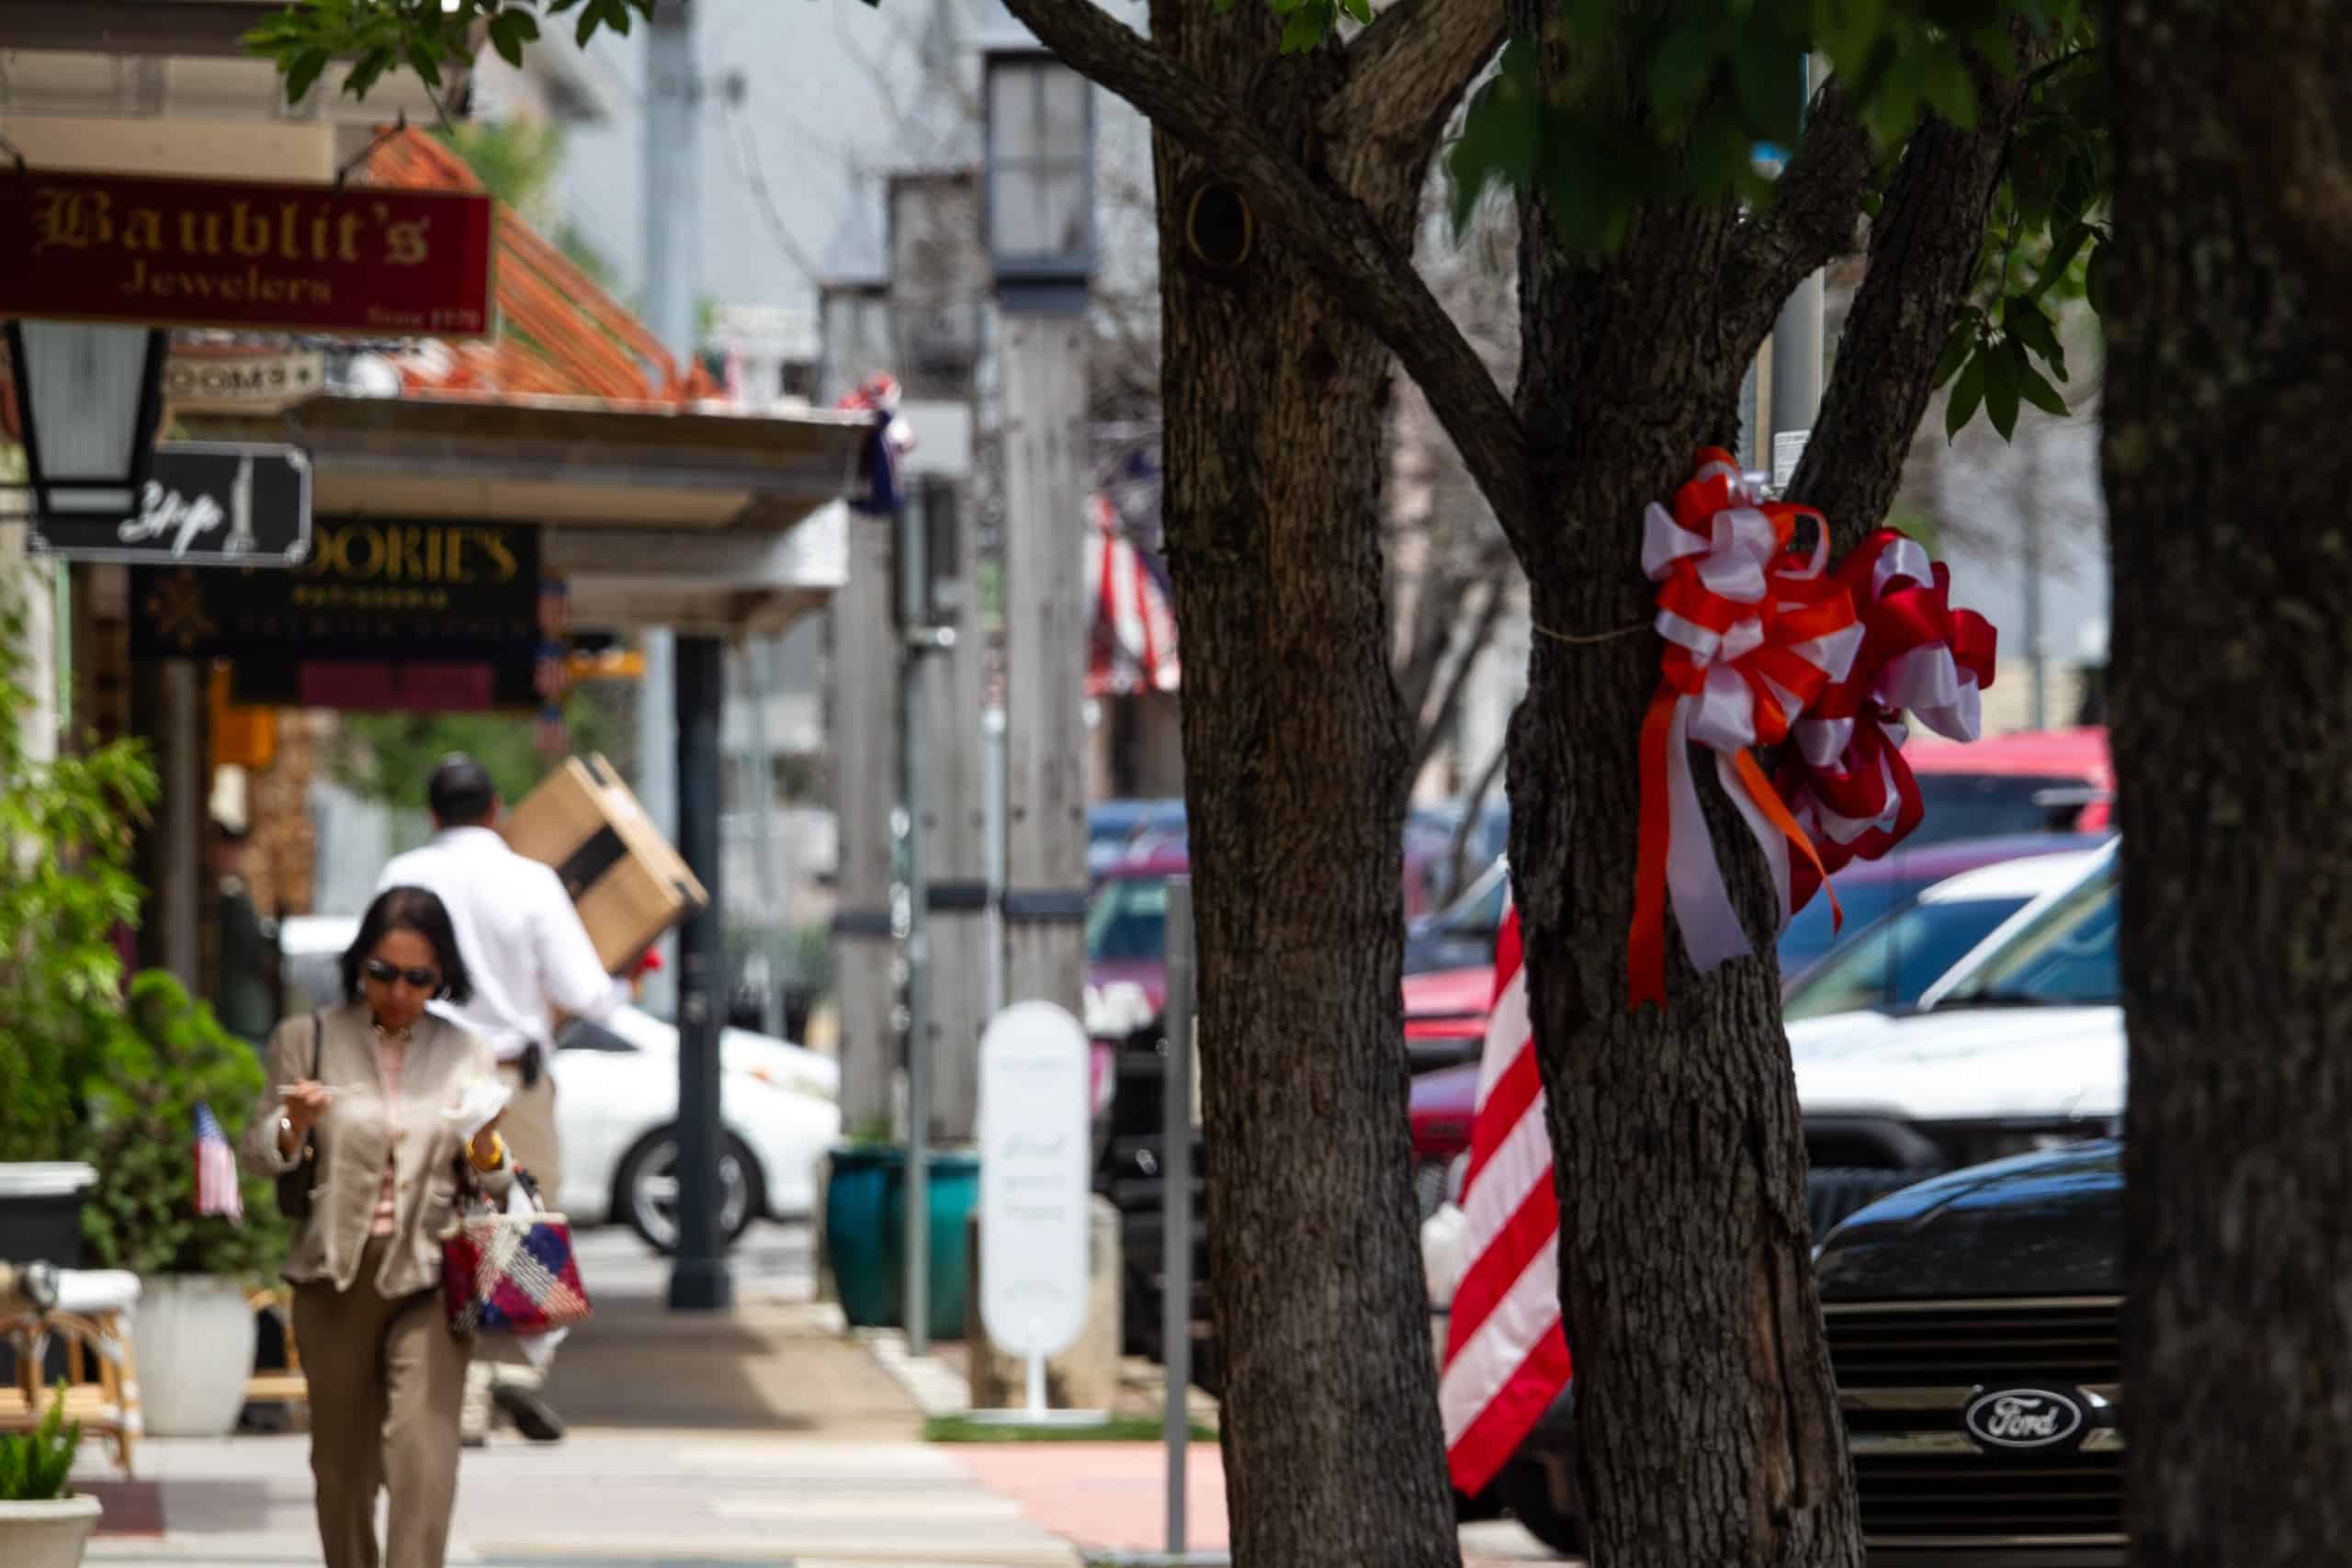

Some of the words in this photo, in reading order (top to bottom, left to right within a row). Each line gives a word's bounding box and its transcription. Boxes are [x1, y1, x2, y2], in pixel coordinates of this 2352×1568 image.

[35, 187, 431, 266] Baublit's
[120, 259, 333, 305] Jewelers
[1987, 1395, 2060, 1438] Ford
